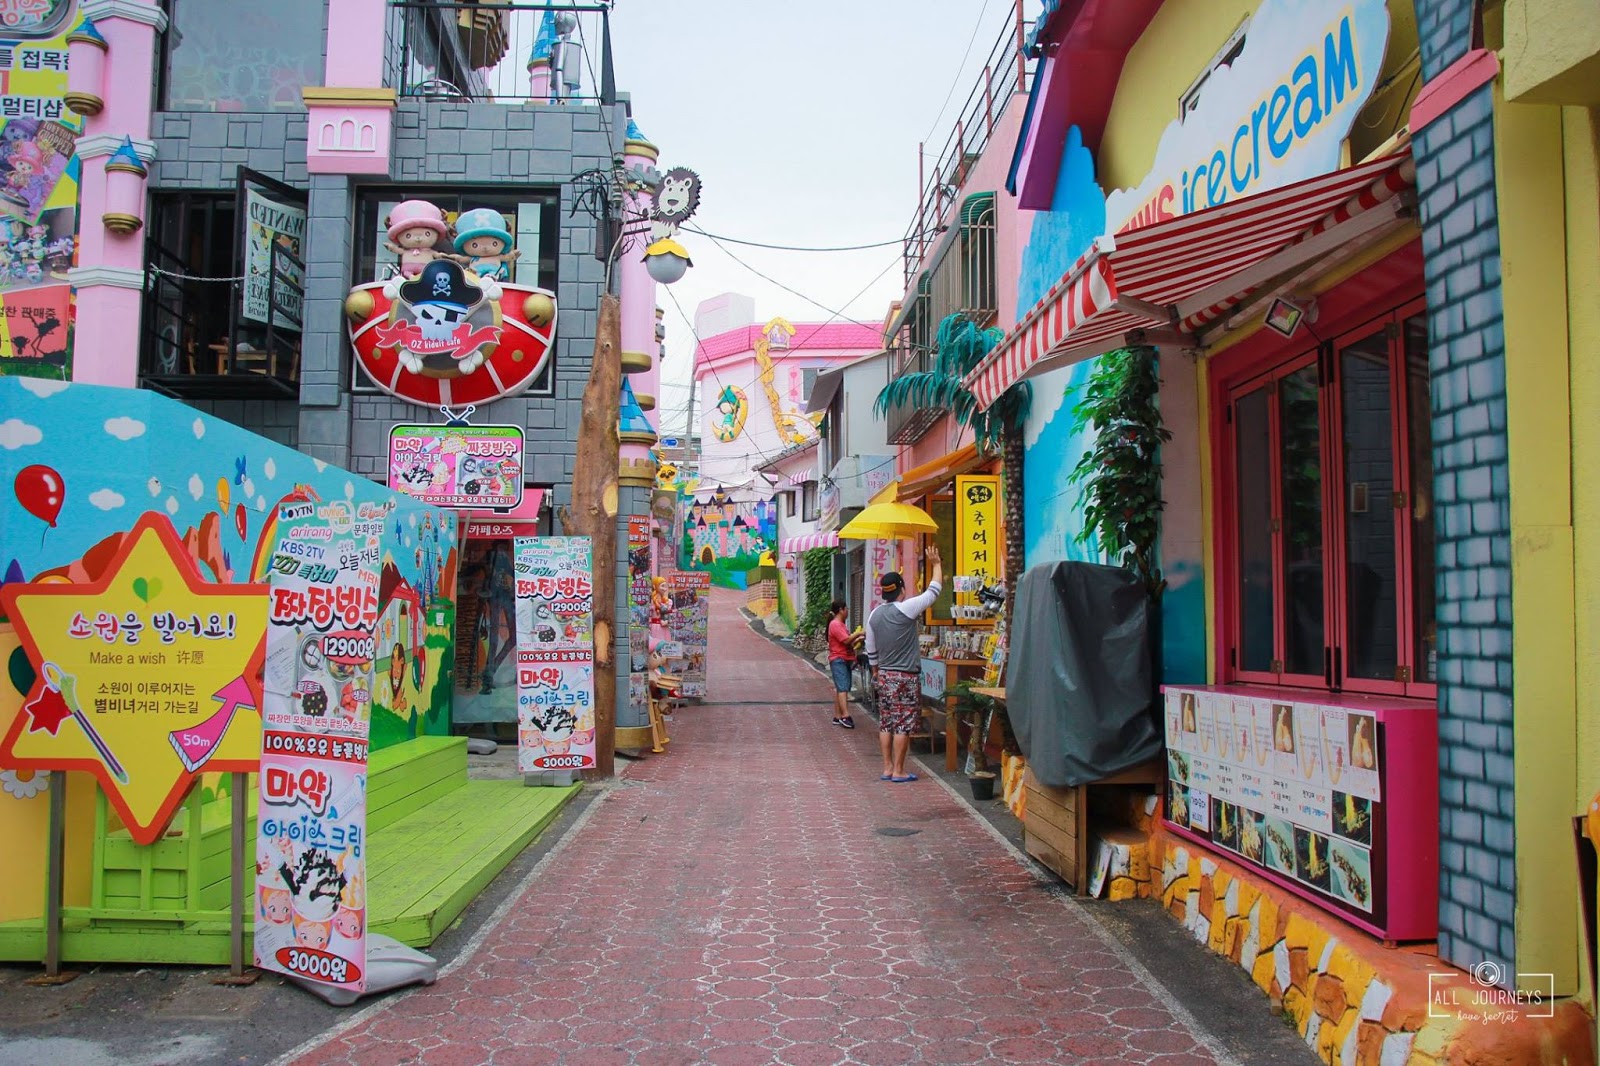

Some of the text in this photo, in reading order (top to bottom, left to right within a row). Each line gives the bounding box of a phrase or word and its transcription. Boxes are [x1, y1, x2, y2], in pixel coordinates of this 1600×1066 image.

[2, 97, 63, 118] 멀티샵
[411, 339, 423, 349] OZ
[395, 438, 421, 452] 마약
[468, 441, 515, 456] 짜장빙수
[394, 453, 442, 464] 아이스크림
[294, 505, 314, 517] YTN
[290, 525, 333, 541] arirang
[353, 523, 383, 536] 문화일보
[280, 541, 325, 560] KBS 2TV
[551, 602, 591, 612] 12900원
[70, 612, 236, 643] 소원을 빌어요!
[323, 637, 375, 660] 12900원
[90, 651, 166, 665] Make a wish
[176, 650, 205, 665] 许愿
[520, 668, 560, 687] 마약
[98, 682, 195, 696] 소원이 이루어지는
[94, 698, 199, 714] 별비녀거리 가는길
[520, 691, 590, 706] 아이스크림
[182, 733, 211, 748] 50m
[265, 735, 328, 756] 100%우유
[541, 755, 583, 768] 3000원
[265, 768, 328, 808] 마약
[262, 818, 362, 858] 아이스크림
[287, 949, 347, 983] 3000원
